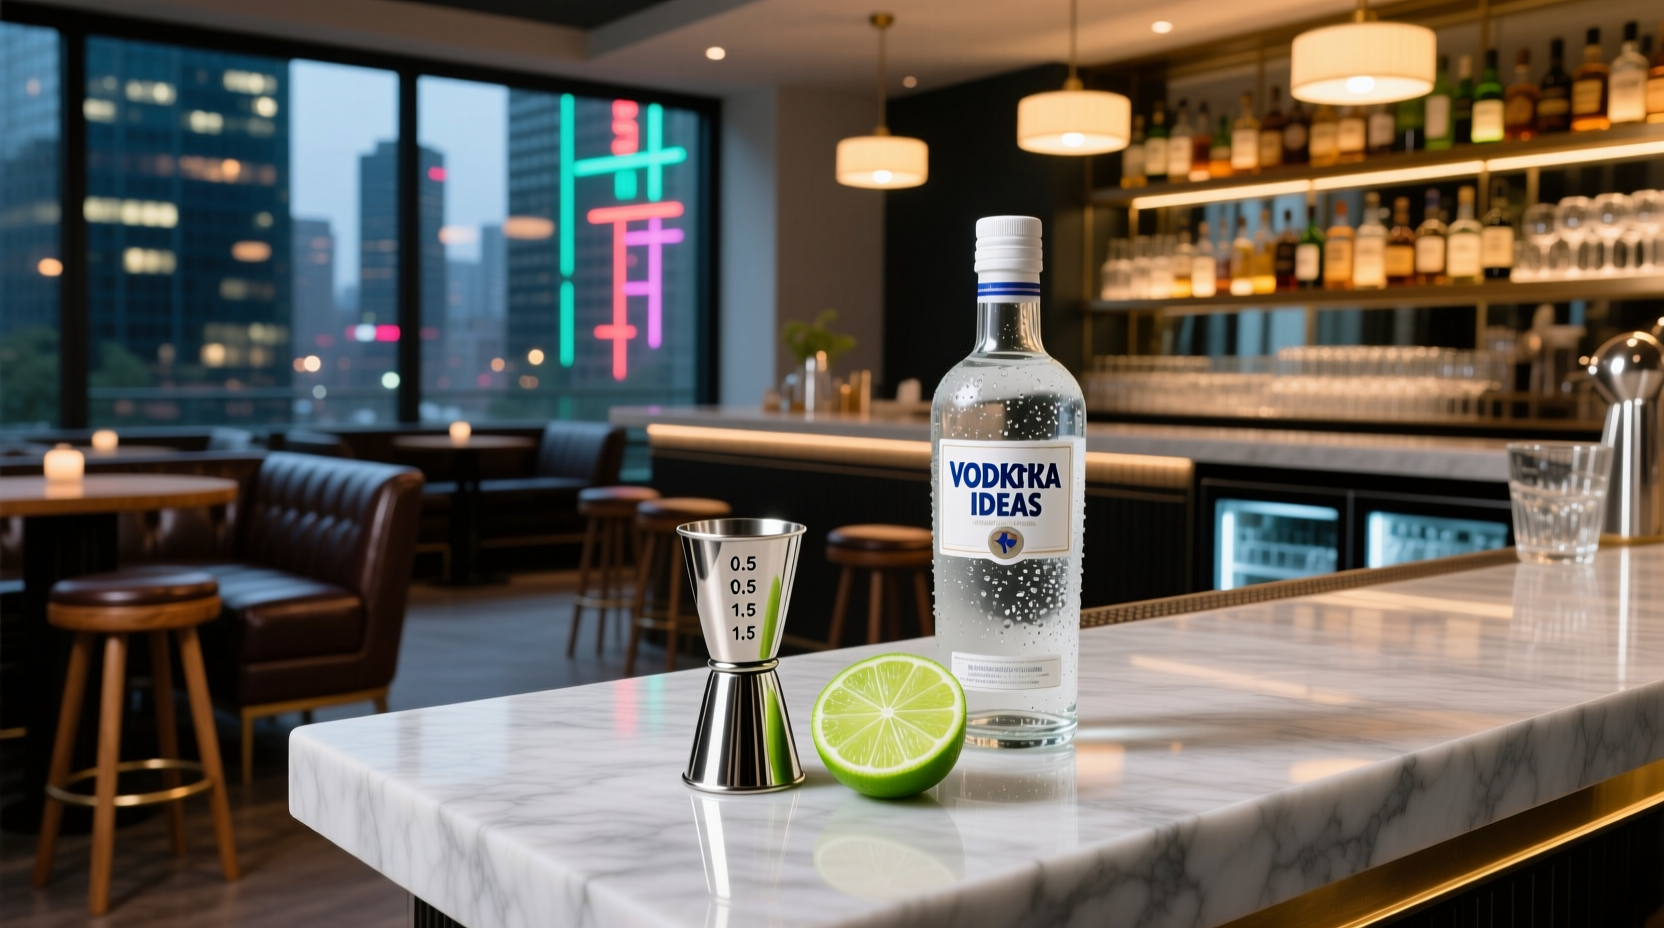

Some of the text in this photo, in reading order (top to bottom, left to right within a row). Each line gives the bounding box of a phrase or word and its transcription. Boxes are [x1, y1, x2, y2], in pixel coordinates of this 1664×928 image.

[970, 491, 1042, 517] IDEAS
[730, 556, 757, 572] 0.5
[730, 579, 757, 595] 0.5
[732, 626, 756, 641] 1.5
